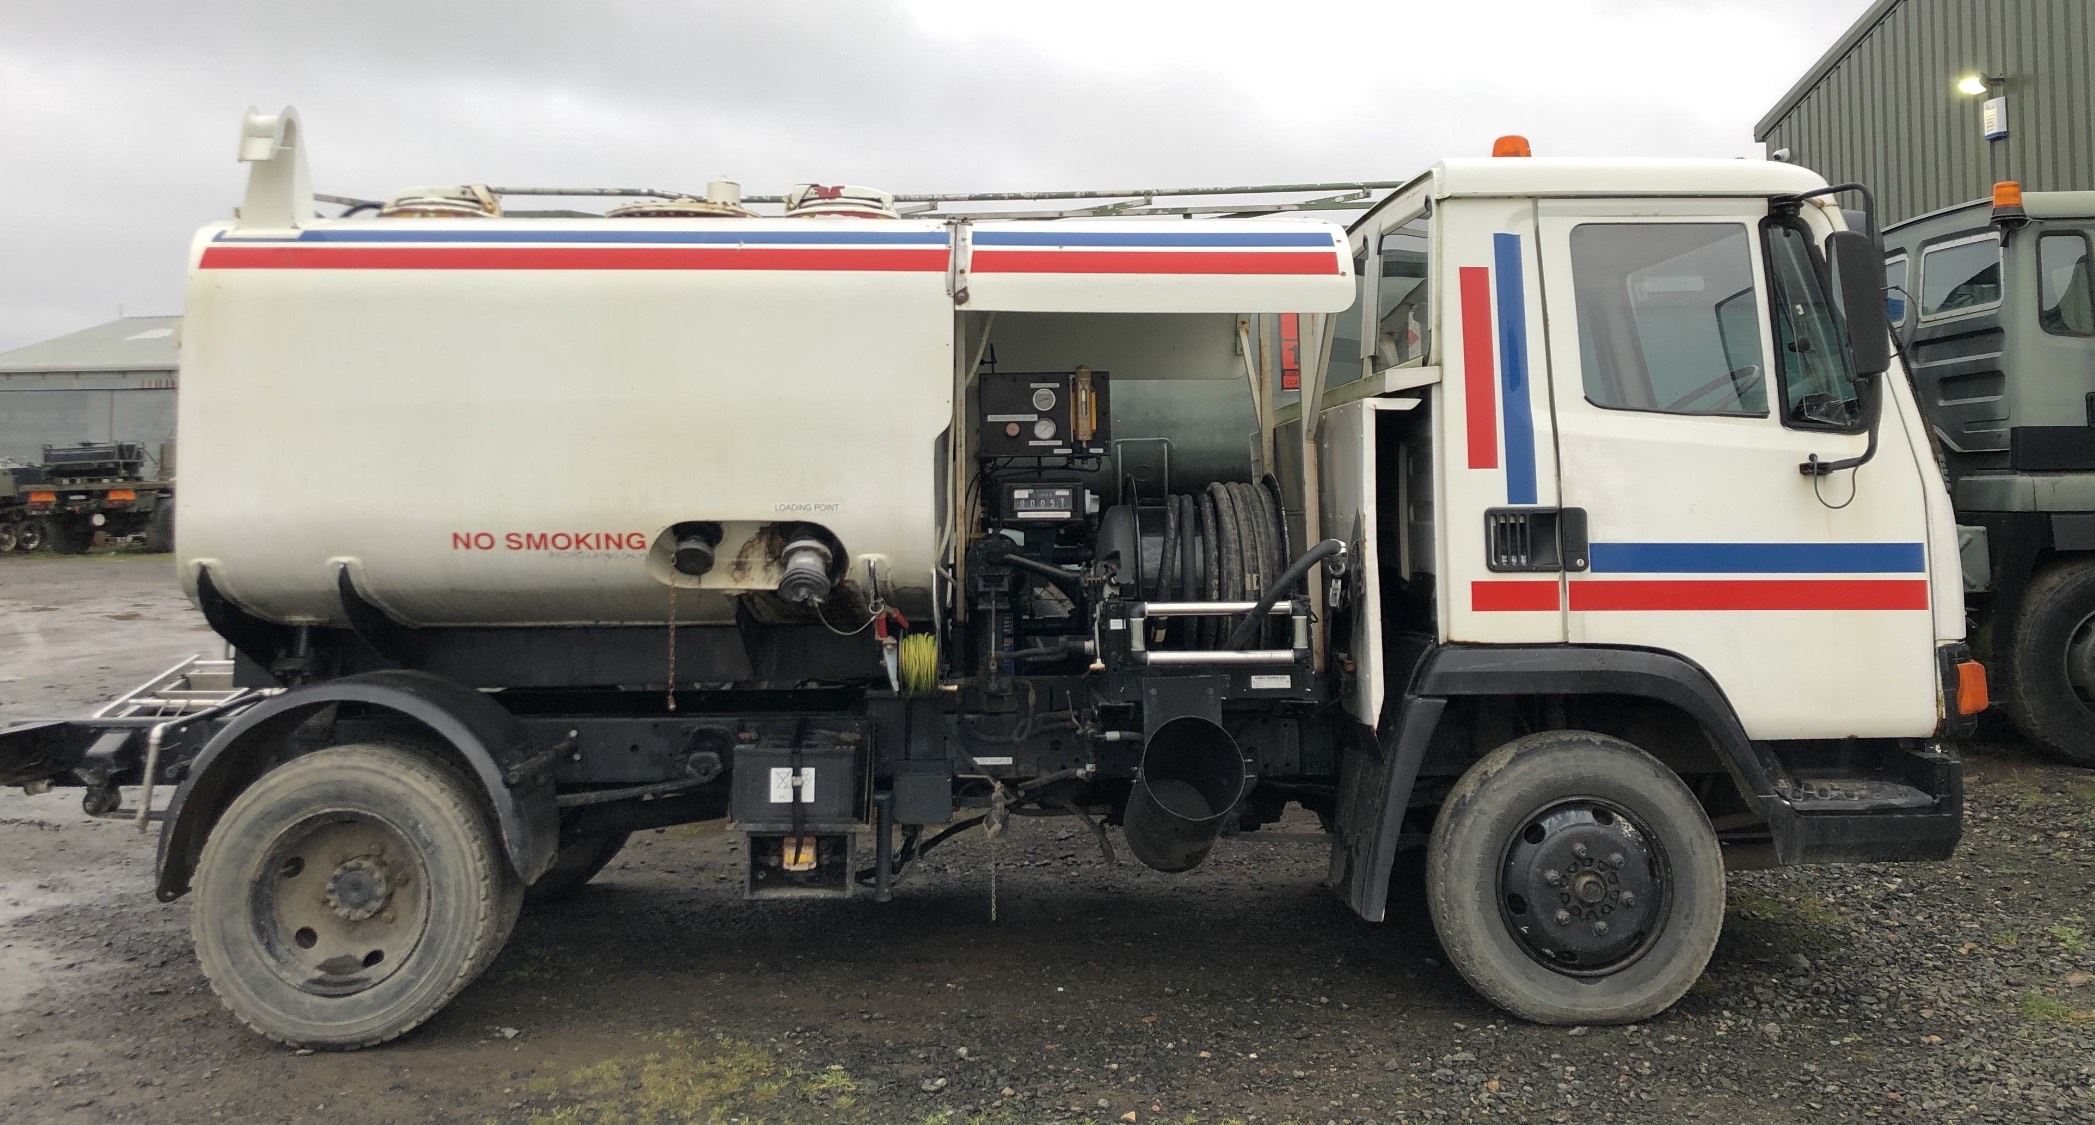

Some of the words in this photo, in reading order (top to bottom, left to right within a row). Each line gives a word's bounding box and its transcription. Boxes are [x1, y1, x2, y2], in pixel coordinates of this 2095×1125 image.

[774, 503, 812, 512] LOADING
[814, 503, 840, 512] POINT
[453, 532, 495, 550] NO
[505, 532, 647, 550] SMOKING
